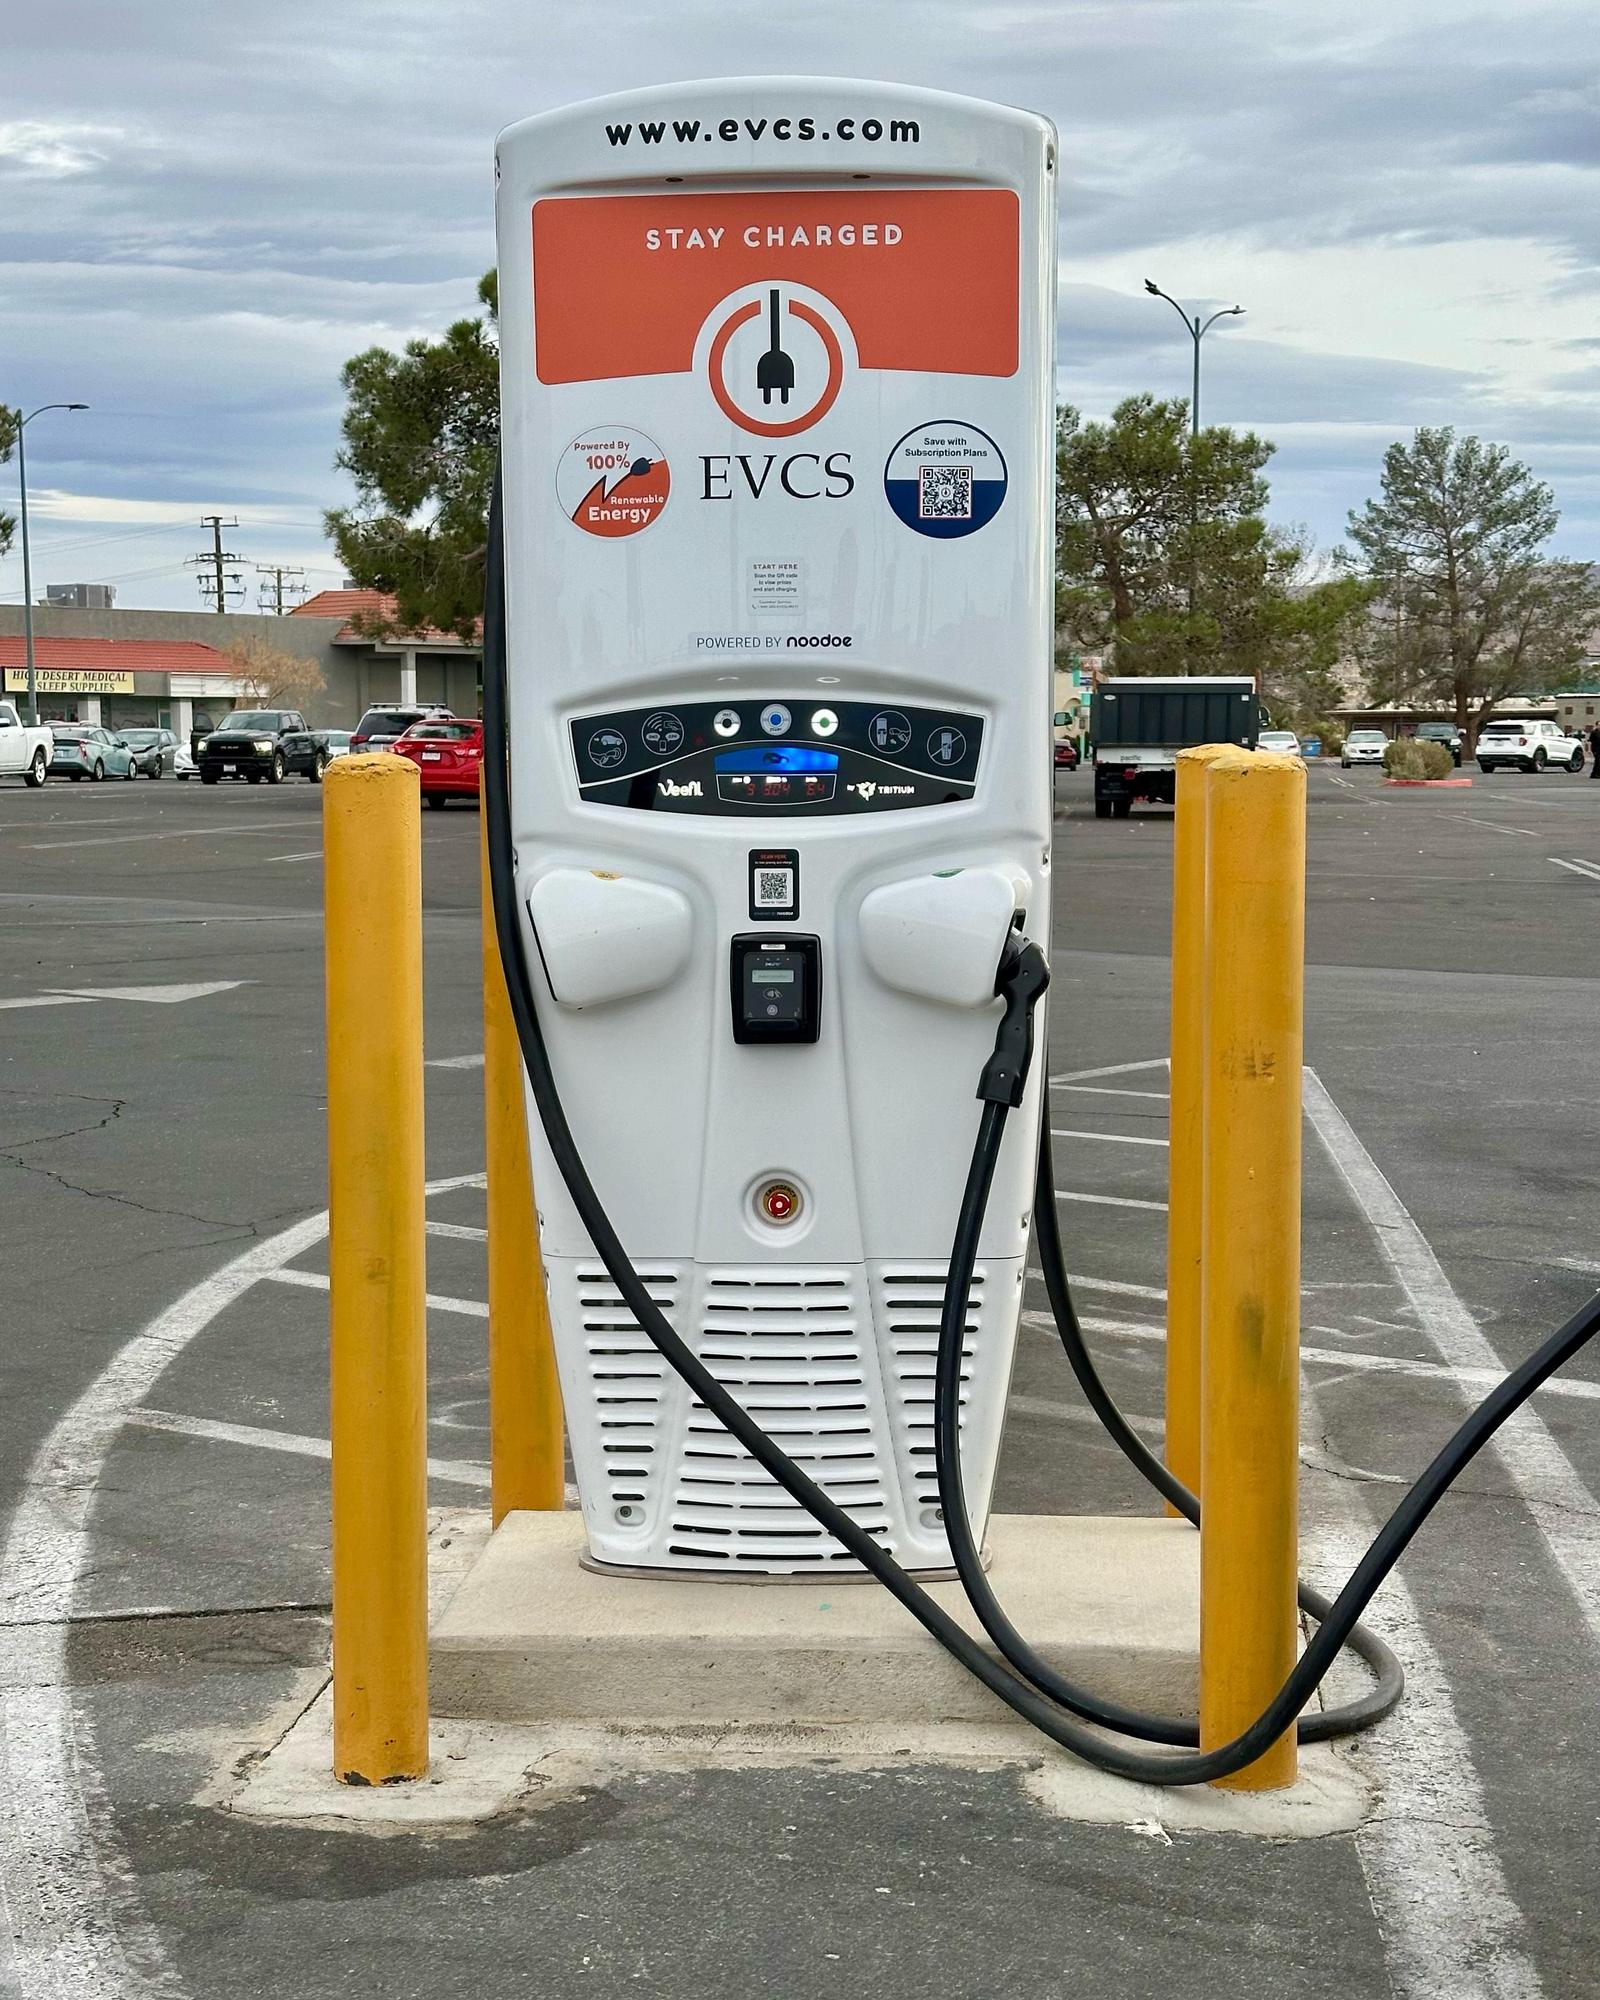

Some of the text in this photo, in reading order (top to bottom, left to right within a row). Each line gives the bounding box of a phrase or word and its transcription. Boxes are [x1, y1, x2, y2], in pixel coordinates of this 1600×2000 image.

[605, 116, 921, 146] www.evcs.com
[645, 224, 904, 250] STAY CHARGED
[574, 441, 630, 451] Powered By
[923, 438, 967, 446] Save with
[905, 448, 988, 459] Subscription Plans
[586, 454, 631, 470] 100%
[698, 453, 855, 500] EVCS
[610, 494, 664, 505] Renewable
[588, 506, 651, 523] Energy
[697, 634, 852, 649] POWERED BY noodoe
[42, 671, 79, 681] DESERT
[82, 672, 127, 682] MEDICAL
[37, 682, 67, 691] SLEEP
[70, 682, 116, 692] SUPPLIES
[878, 786, 915, 794] TRITIUM
